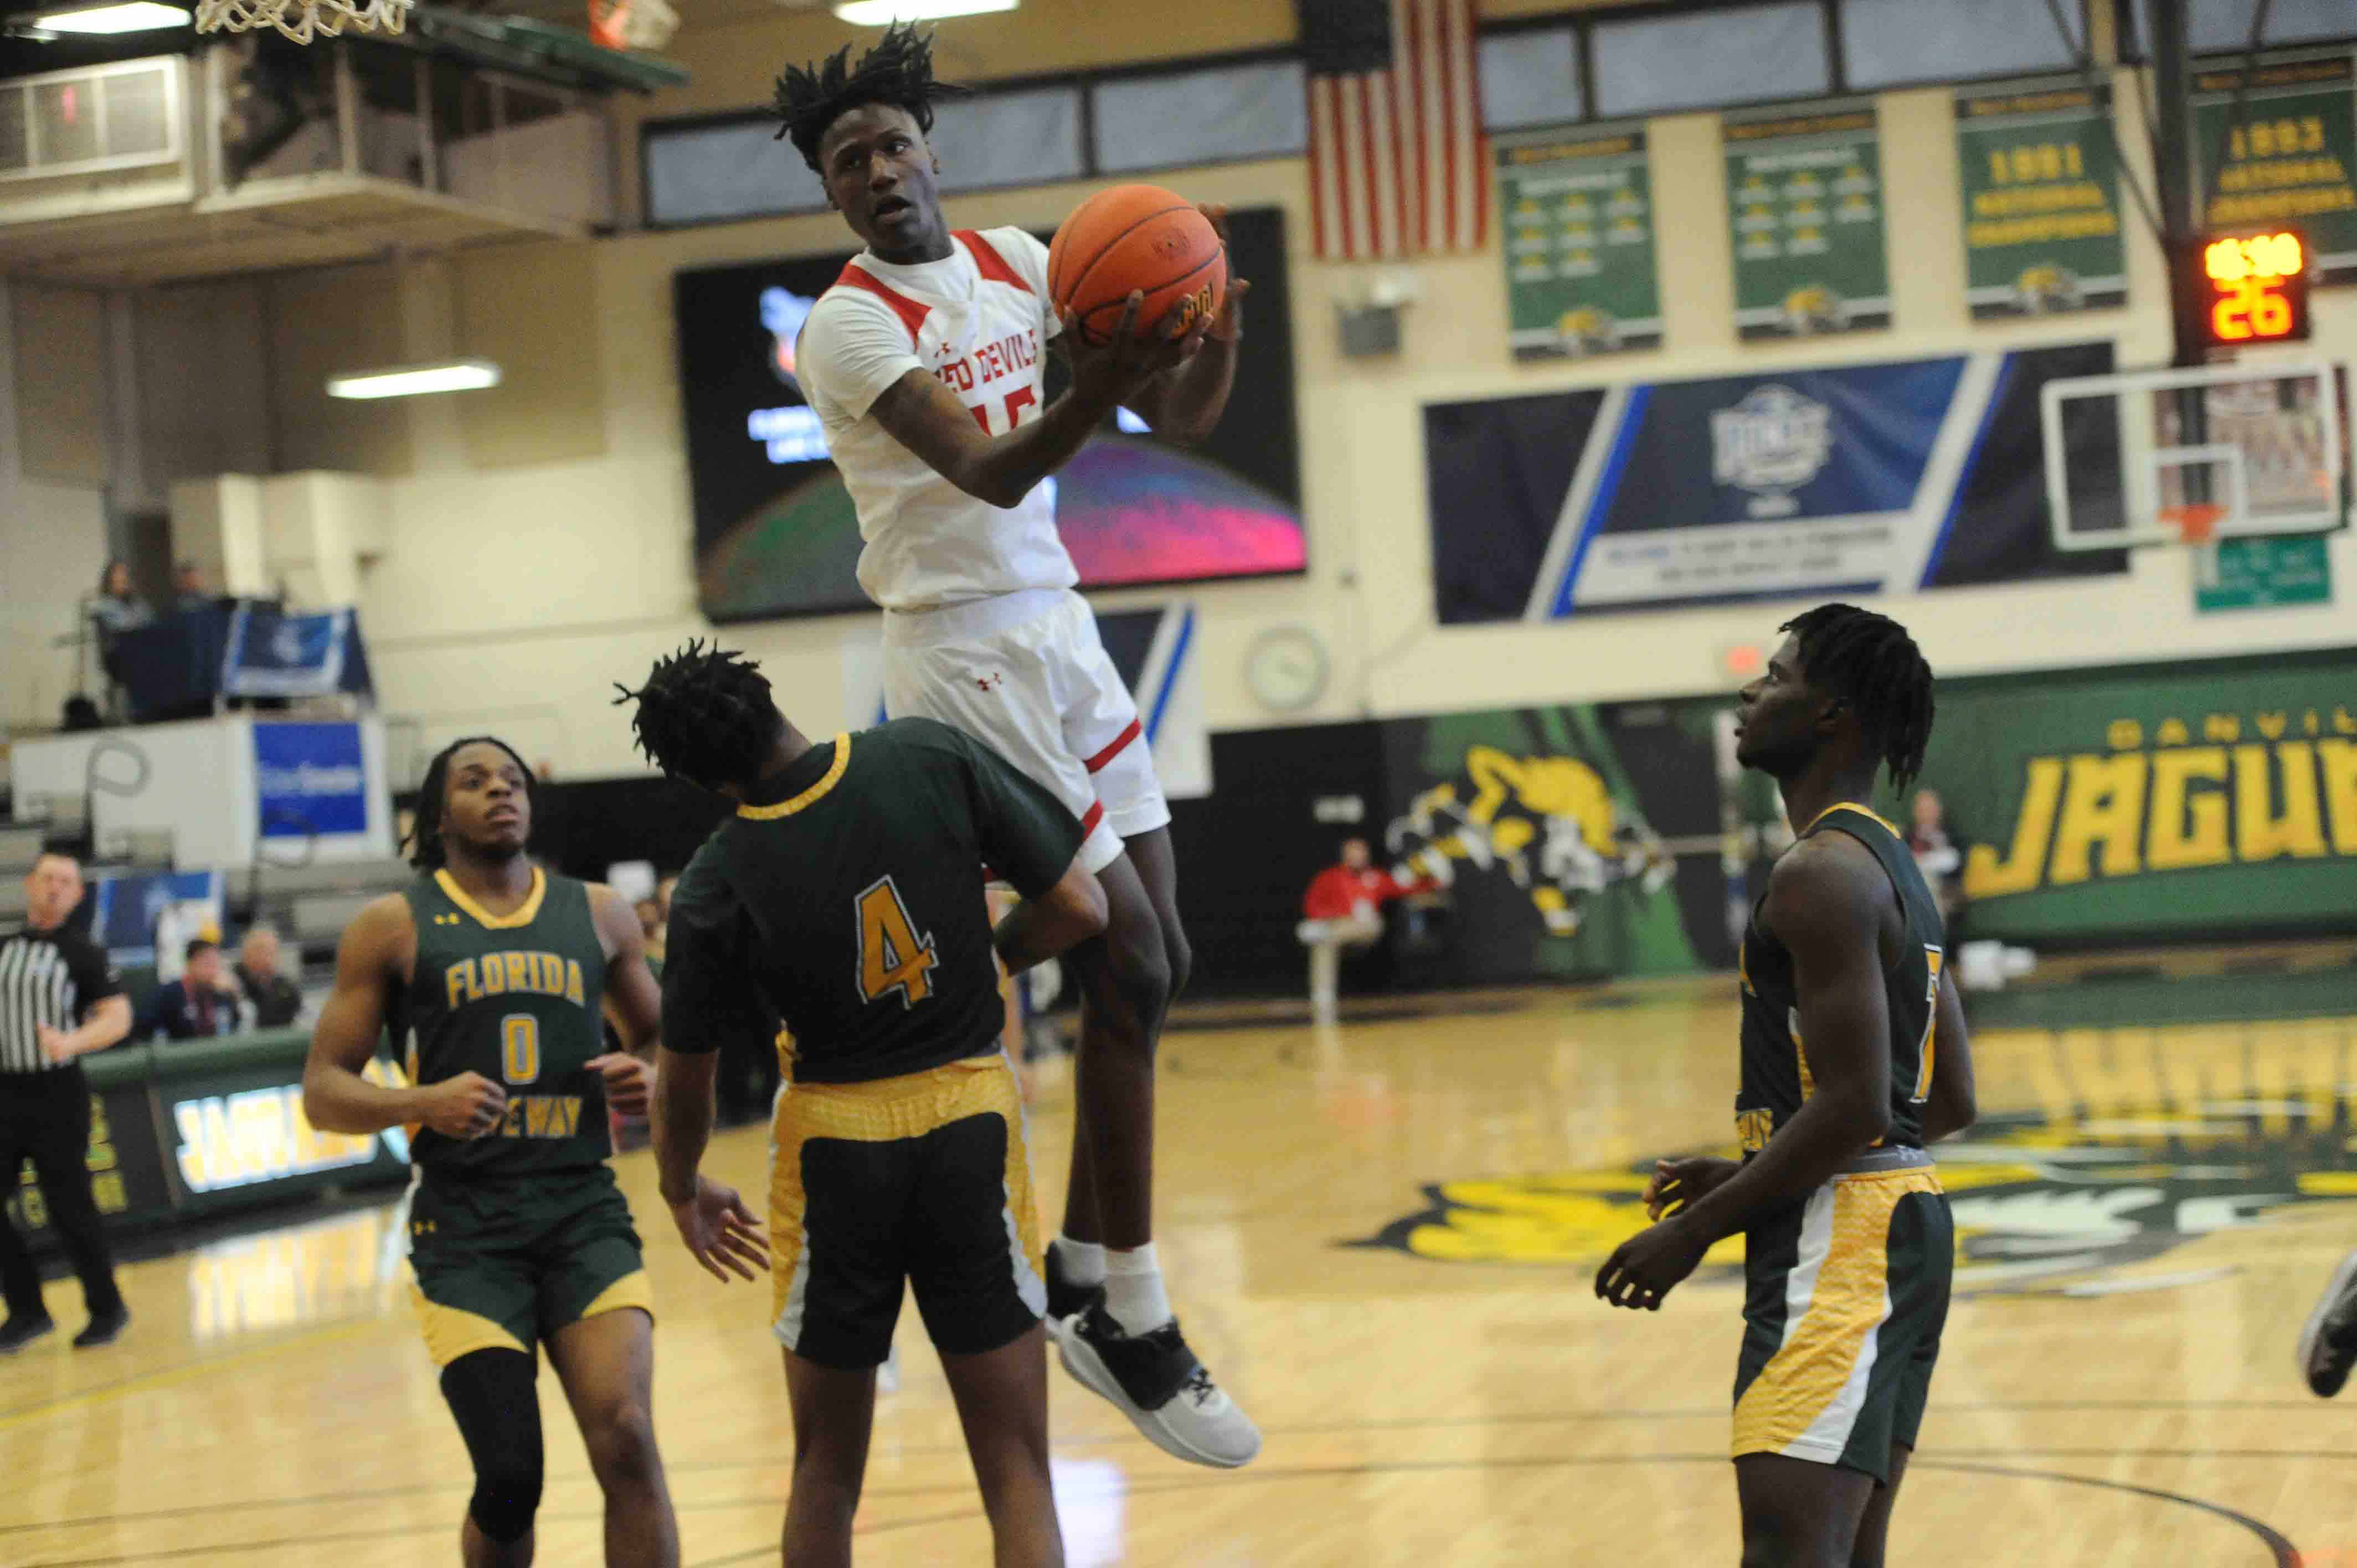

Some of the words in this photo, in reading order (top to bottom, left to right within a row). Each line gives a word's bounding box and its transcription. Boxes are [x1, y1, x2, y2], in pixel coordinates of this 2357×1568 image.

[853, 873, 940, 1010] 4
[445, 950, 586, 1012] FLORIDA
[500, 1013, 539, 1086] 0
